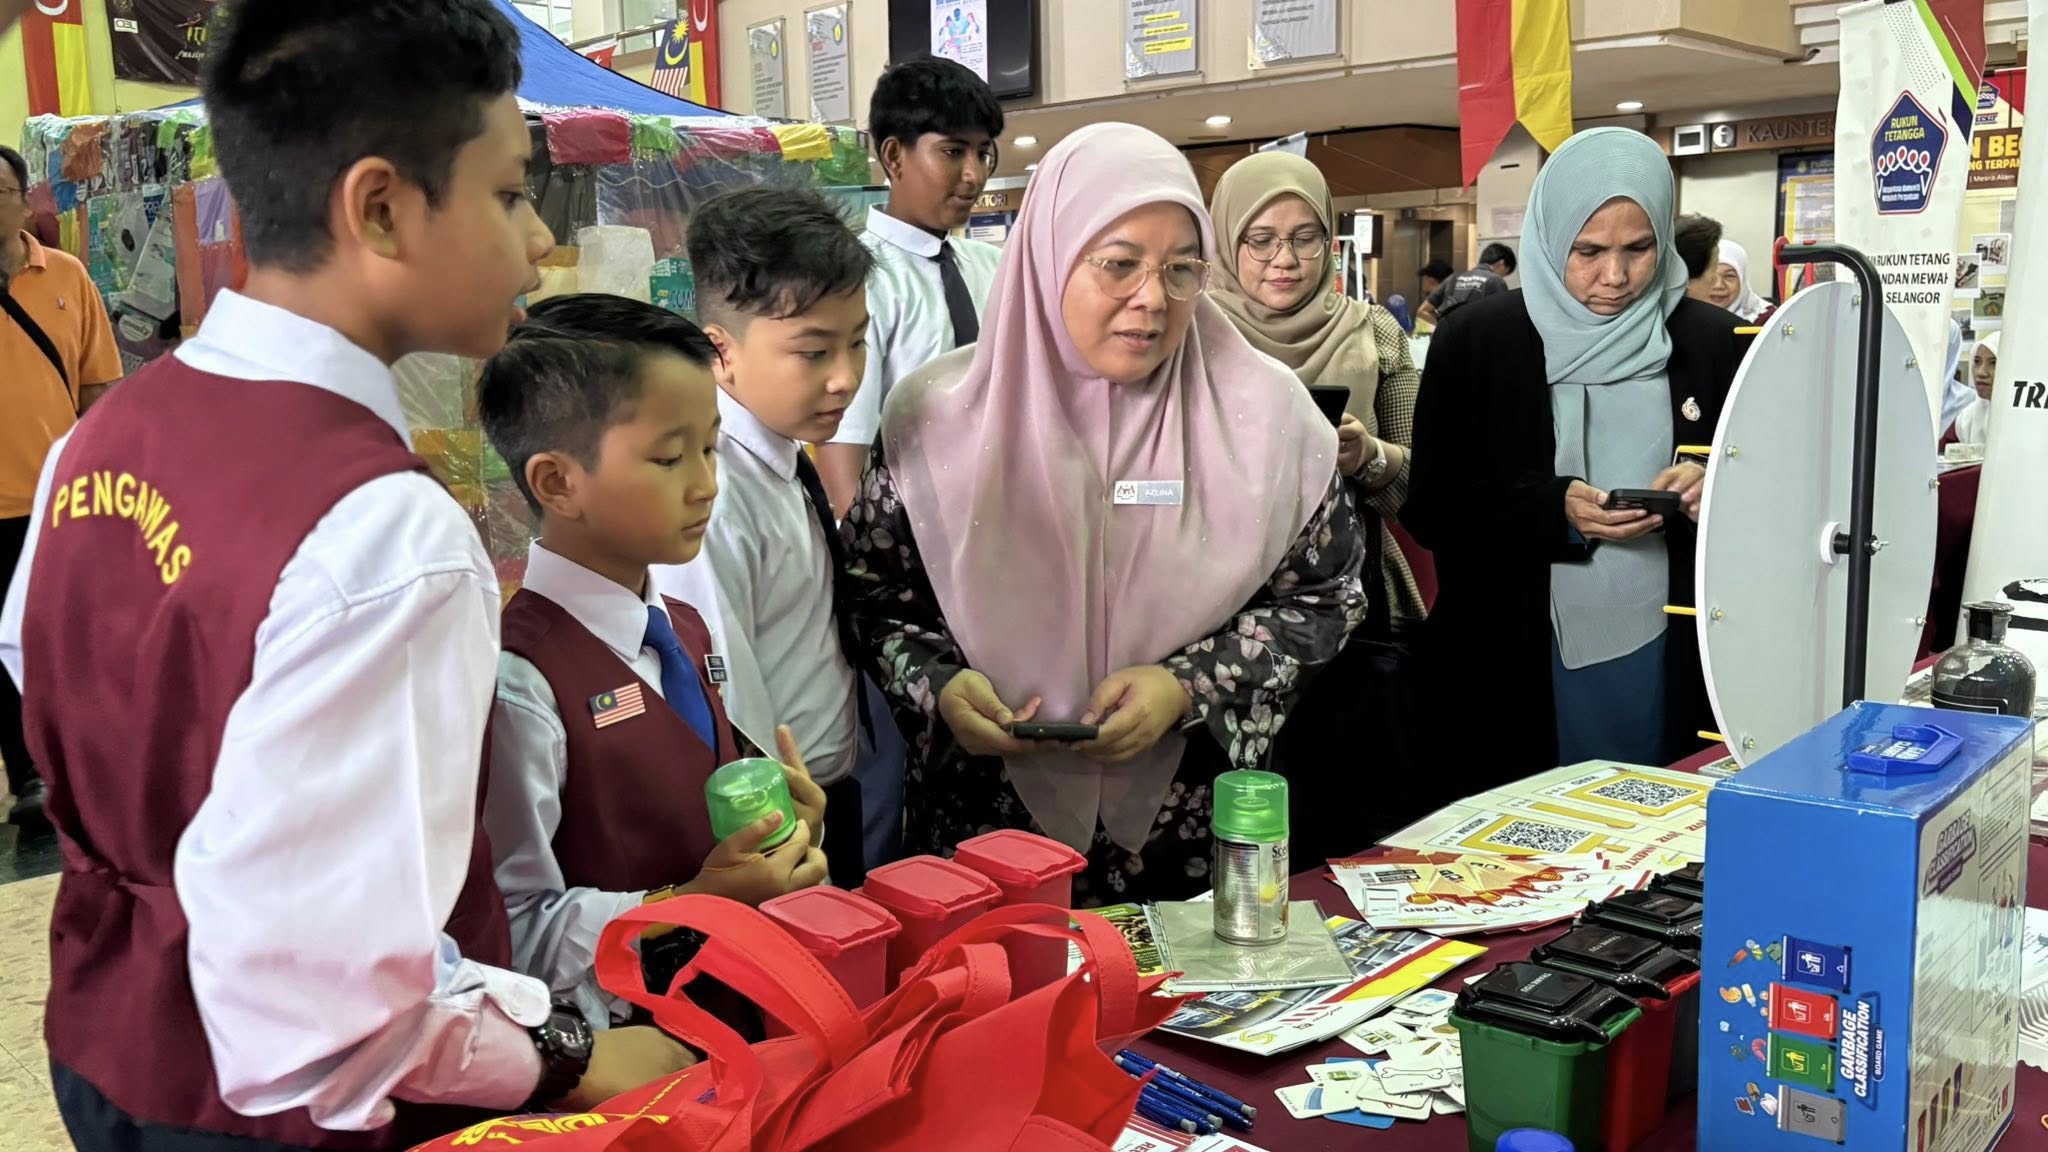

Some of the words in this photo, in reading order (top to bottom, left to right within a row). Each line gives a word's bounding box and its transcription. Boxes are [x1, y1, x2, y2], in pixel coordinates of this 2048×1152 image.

[1891, 115, 1918, 128] RUKUN
[1885, 127, 1925, 142] TETANGGA
[1988, 134, 2022, 158] BE
[1880, 273, 1909, 285] NDAN
[1885, 292, 1940, 304] SELANGOR
[2012, 381, 2048, 409] TR
[53, 470, 191, 584] PENGAWAS
[1841, 1009, 1857, 1080] GARBAGE
[1854, 1001, 1870, 1097] CLASSIFICATION
[1875, 1052, 1883, 1075] BOARD
